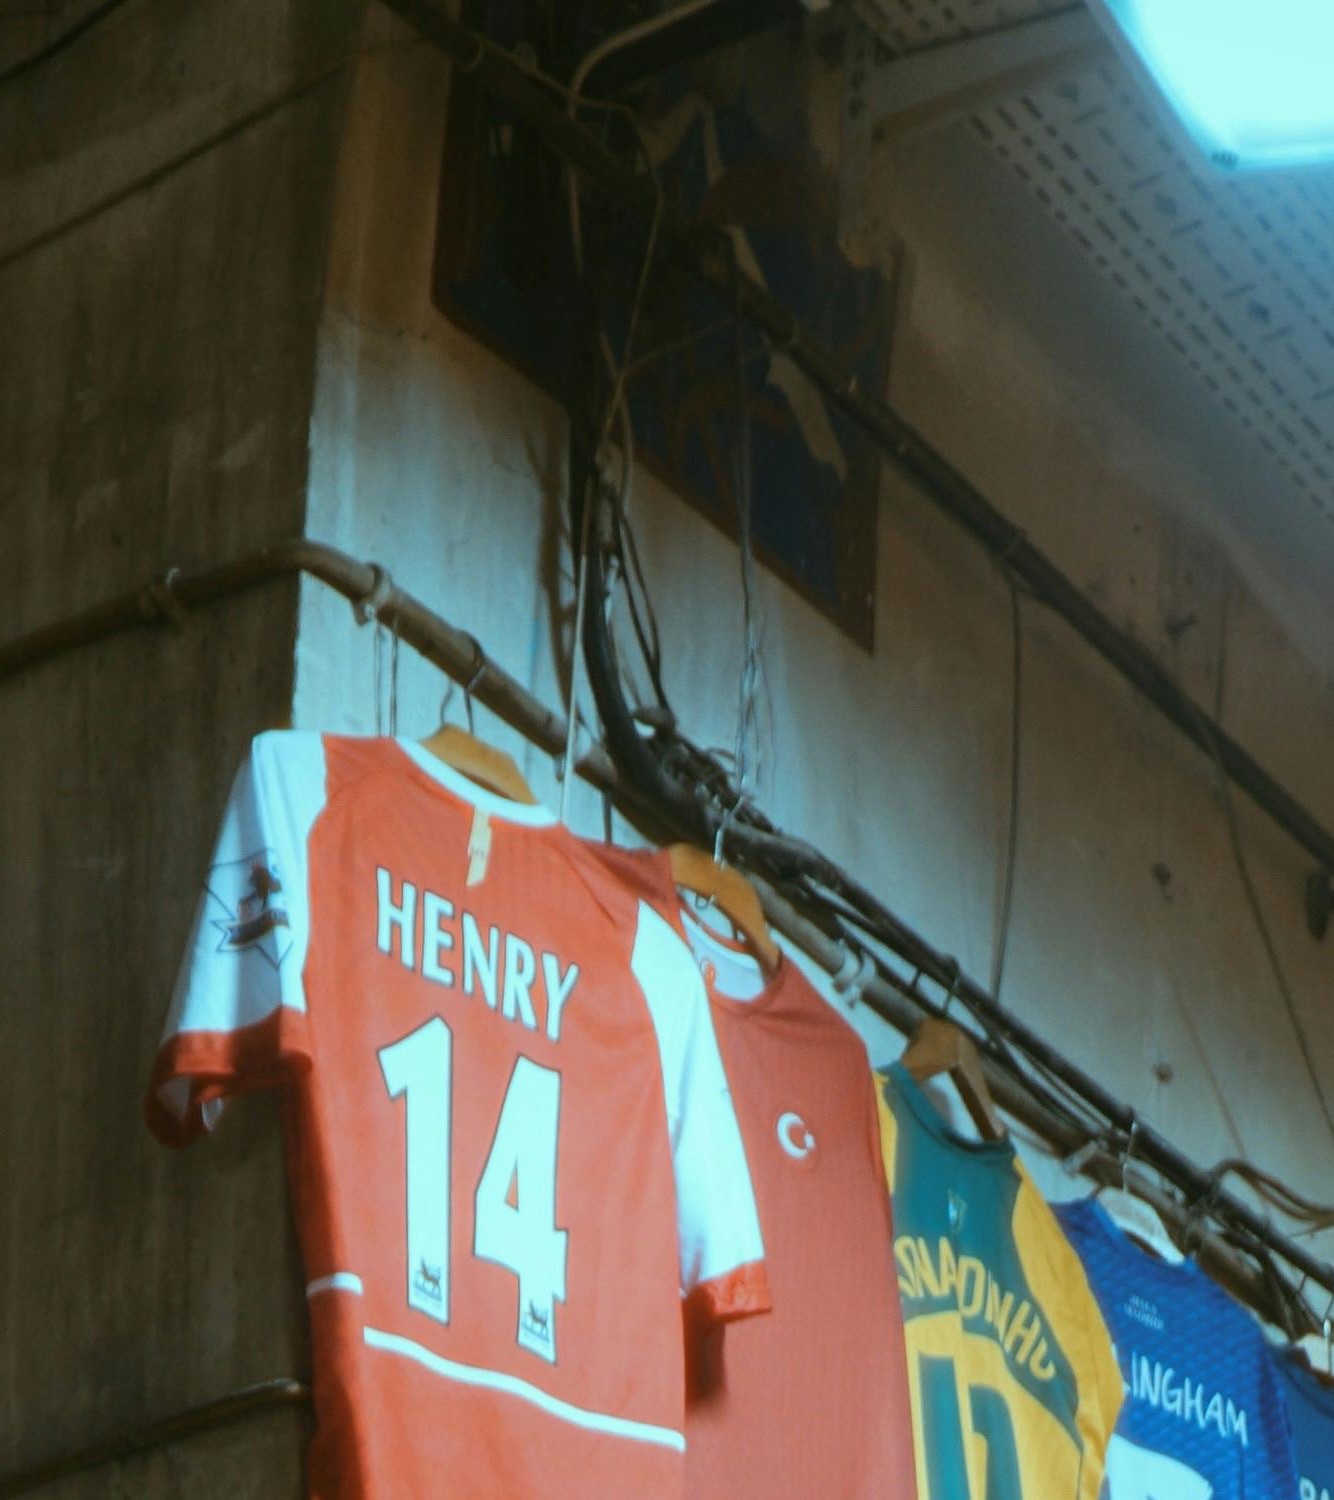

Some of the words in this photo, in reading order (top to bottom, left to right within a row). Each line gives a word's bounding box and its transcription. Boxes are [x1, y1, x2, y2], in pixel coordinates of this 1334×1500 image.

[375, 866, 579, 1043] HENRY
[377, 1014, 568, 1367] 14
[1124, 1350, 1248, 1448] INGHAM
